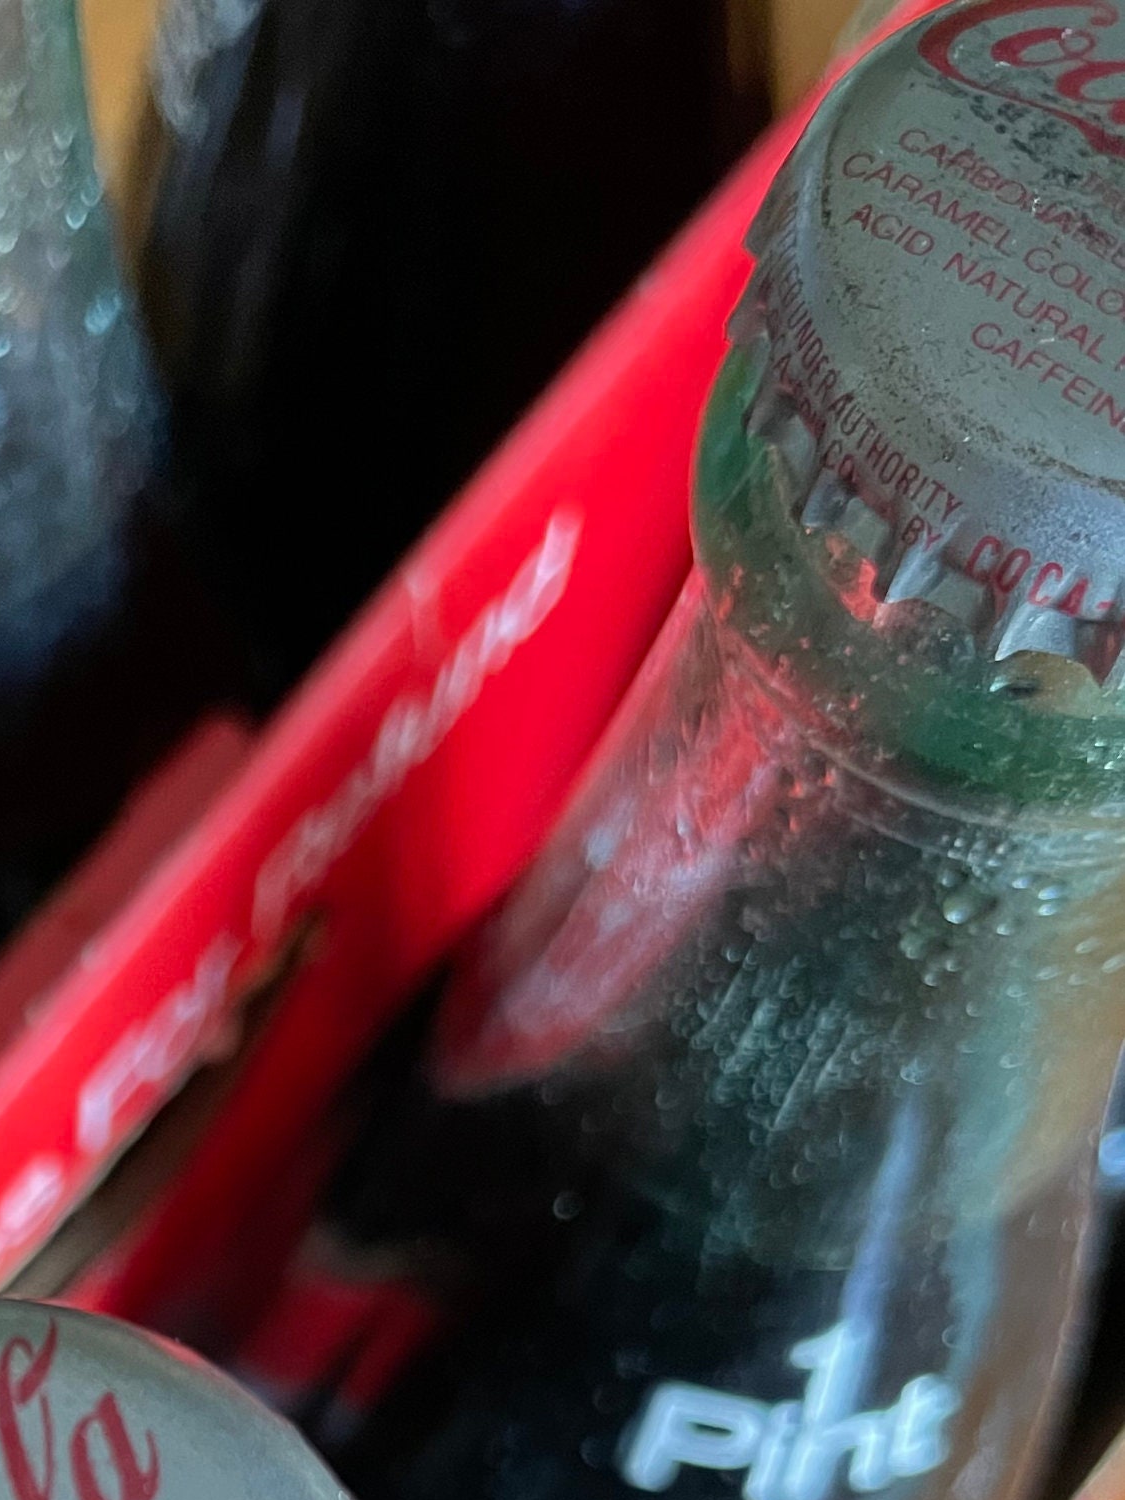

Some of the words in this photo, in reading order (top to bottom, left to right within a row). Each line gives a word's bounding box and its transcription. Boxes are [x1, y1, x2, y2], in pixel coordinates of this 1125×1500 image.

[842, 152, 1012, 258] CARAMEL
[1024, 247, 1125, 322] COLO
[942, 252, 1106, 365] NATURAL
[788, 300, 841, 398] UNDER
[827, 391, 964, 523] AUTHORITY
[971, 322, 1125, 435] CAFFEIN
[901, 514, 942, 551] BY
